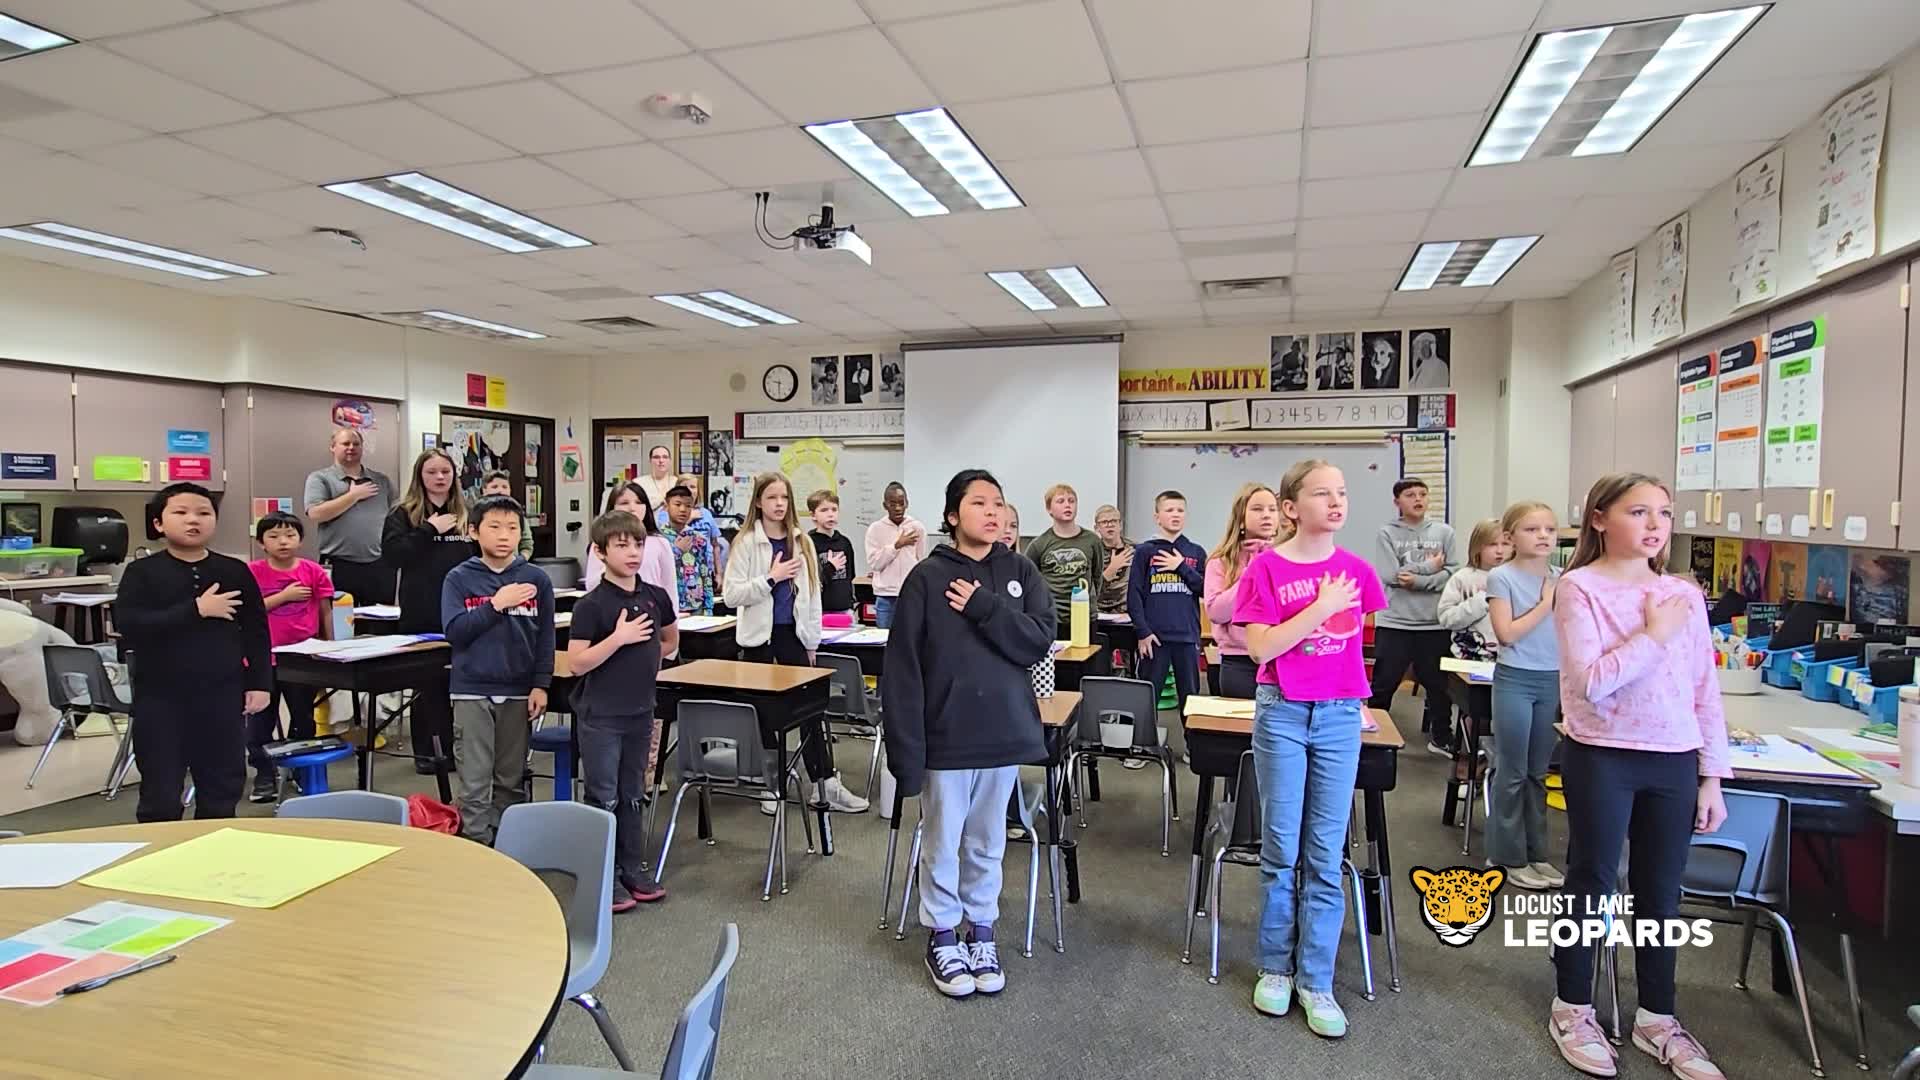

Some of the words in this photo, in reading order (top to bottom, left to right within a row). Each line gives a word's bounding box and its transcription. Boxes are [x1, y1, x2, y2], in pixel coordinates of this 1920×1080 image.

[1119, 373, 1175, 392] portant
[1279, 407, 1285, 423] 3
[1289, 407, 1300, 422] 4
[1303, 406, 1313, 423] 5
[1317, 406, 1327, 422] 6
[1335, 406, 1345, 422] 7
[1351, 406, 1361, 421] 8
[1278, 578, 1317, 606] FARM
